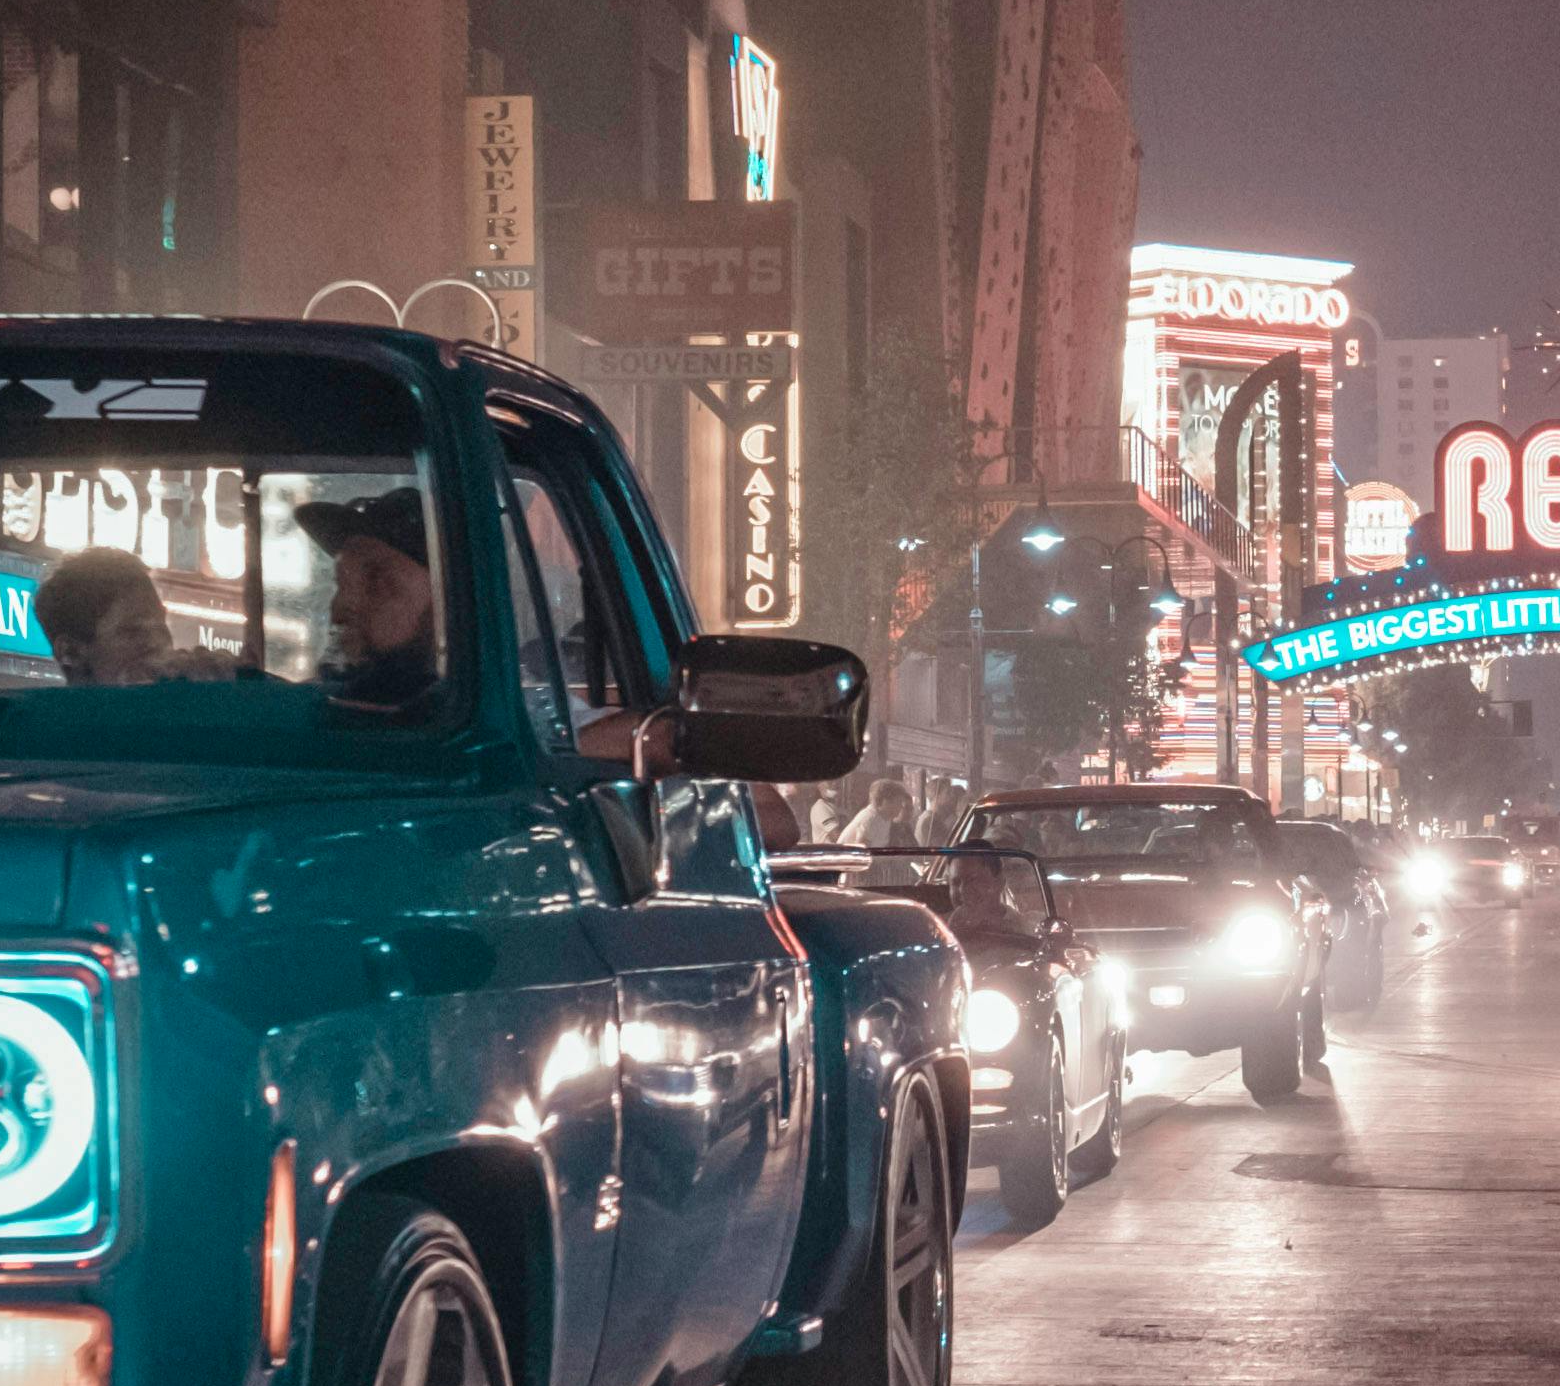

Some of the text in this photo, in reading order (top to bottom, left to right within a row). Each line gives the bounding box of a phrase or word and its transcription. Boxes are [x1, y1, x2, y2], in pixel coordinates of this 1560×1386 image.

[478, 101, 520, 261] JEWELRY
[477, 269, 531, 289] AND
[594, 246, 783, 296] GIFTS
[482, 298, 520, 345] LO
[600, 351, 774, 375] SOUVENIRS
[1204, 384, 1280, 417] ME
[740, 424, 777, 613] CASINO
[1274, 629, 1339, 670] THE
[1348, 602, 1480, 651] BIGGEST
